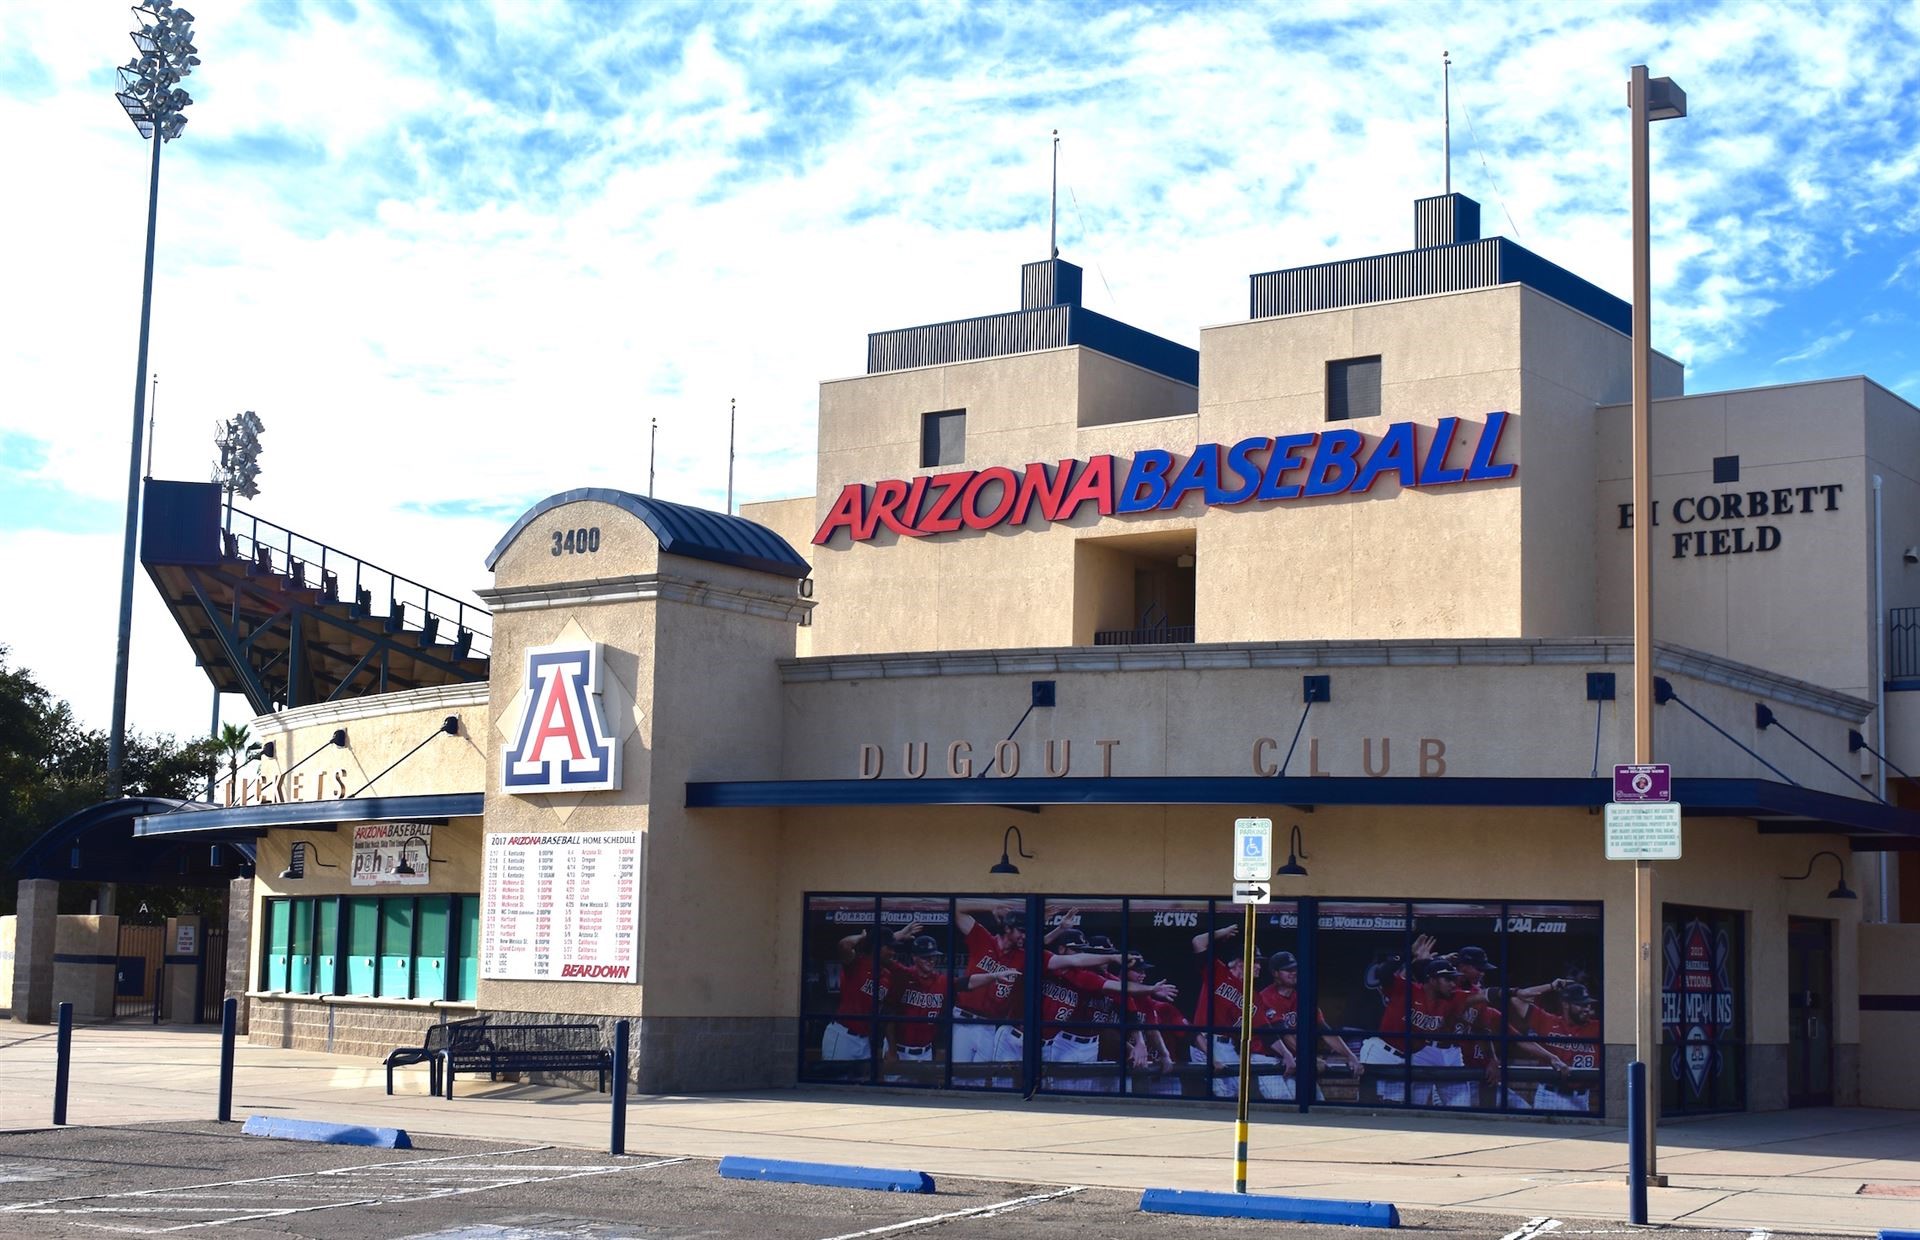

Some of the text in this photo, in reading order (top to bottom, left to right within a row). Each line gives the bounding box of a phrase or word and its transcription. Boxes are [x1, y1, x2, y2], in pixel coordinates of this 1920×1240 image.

[1672, 484, 1843, 524] CORBETT
[550, 526, 601, 557] 3400
[1672, 525, 1782, 558] FIELD
[858, 736, 1448, 780] DUGOUT CLUB
[491, 835, 636, 846] 2017 ARIZONA BASEBALL HOME SCHEDULE
[880, 911, 913, 922] WORLD
[914, 911, 949, 922] SERIES
[1153, 911, 1198, 927] #CWS
[1333, 916, 1373, 928] WORLD
[1573, 1054, 1595, 1068] 28
